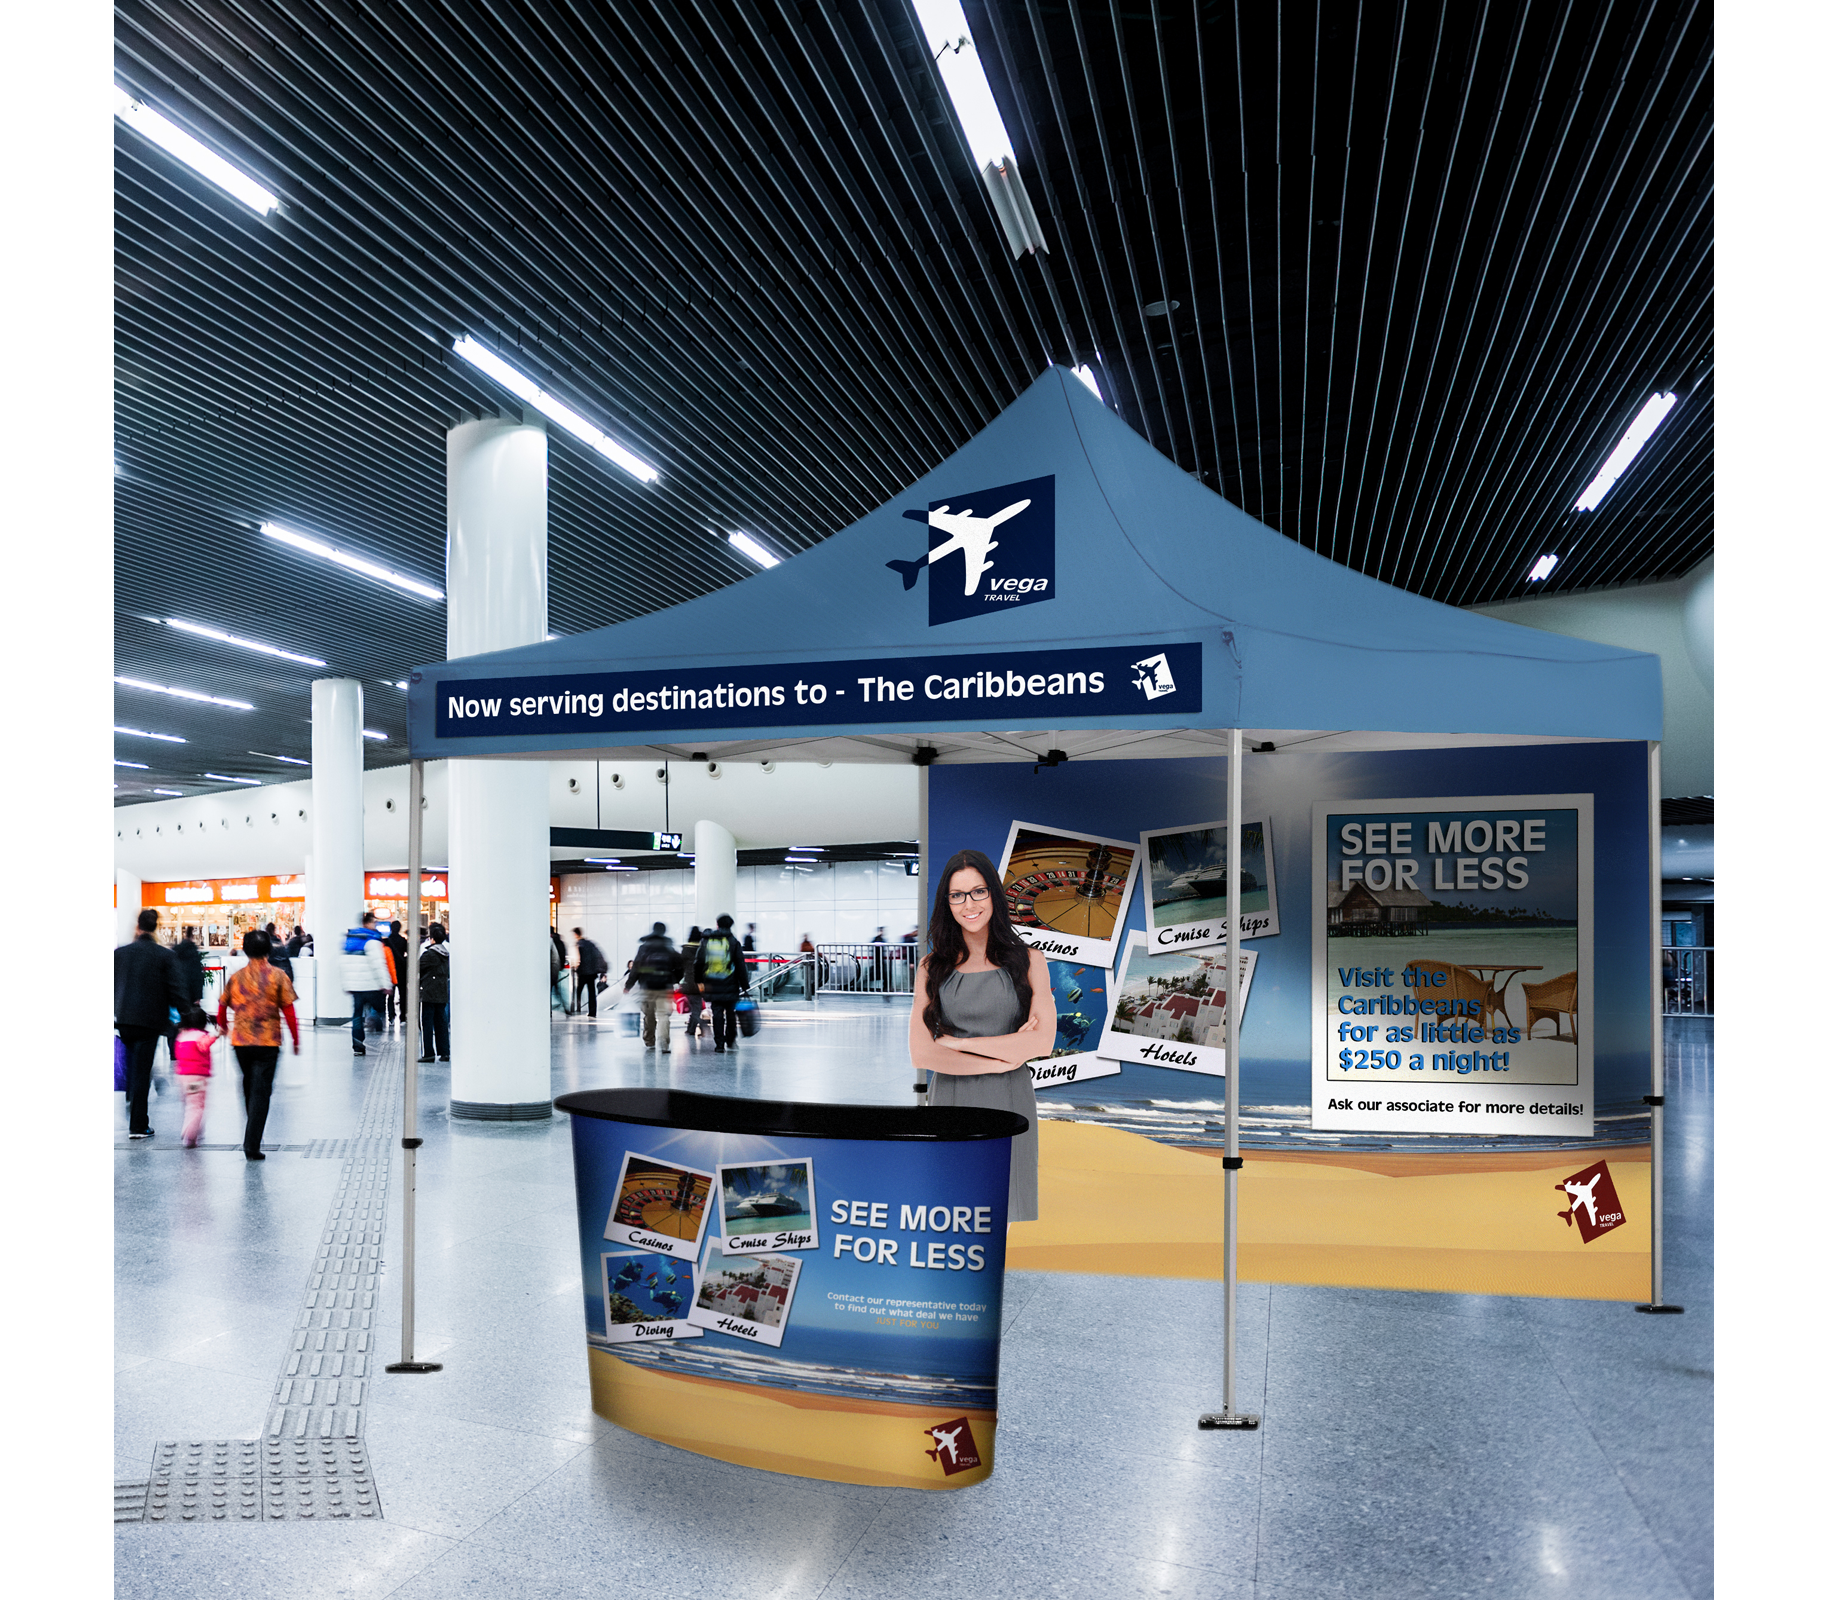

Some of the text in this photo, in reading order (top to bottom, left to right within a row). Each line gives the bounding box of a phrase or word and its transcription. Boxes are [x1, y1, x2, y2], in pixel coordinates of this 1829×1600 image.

[990, 578, 1048, 593] vega
[448, 696, 501, 719] Now
[509, 690, 603, 717] serving
[612, 682, 785, 712] destinations
[794, 680, 827, 704] to
[857, 677, 914, 702] The
[924, 671, 1105, 700] Caribbeans
[1341, 819, 1546, 855] SEE MORE
[1342, 856, 1529, 891] FOR LESS
[1158, 928, 1210, 945] Cruise
[1338, 967, 1447, 987] Visit the
[1338, 995, 1481, 1016] Caribbeans
[1338, 1021, 1521, 1044] for as little as
[1140, 1043, 1197, 1066] Hotels
[1339, 1047, 1510, 1074] $250 a night!
[1328, 1099, 1584, 1115] Ask our associate for more details!
[830, 1199, 992, 1233] SEE MORE
[1599, 1212, 1621, 1222] vega
[628, 1231, 674, 1252] Casinos
[729, 1232, 811, 1249] Cruise Ships
[833, 1234, 985, 1271] FOR LESS
[827, 1292, 987, 1312] Contact our representative today
[834, 1303, 845, 1311] to
[848, 1304, 867, 1313] find
[869, 1307, 886, 1315] out
[889, 1308, 913, 1318] what
[916, 1310, 936, 1319] deal
[955, 1312, 979, 1321] have
[632, 1324, 674, 1338] Diving
[717, 1318, 758, 1338] Hotels
[875, 1316, 939, 1330] JUST FOR YOU
